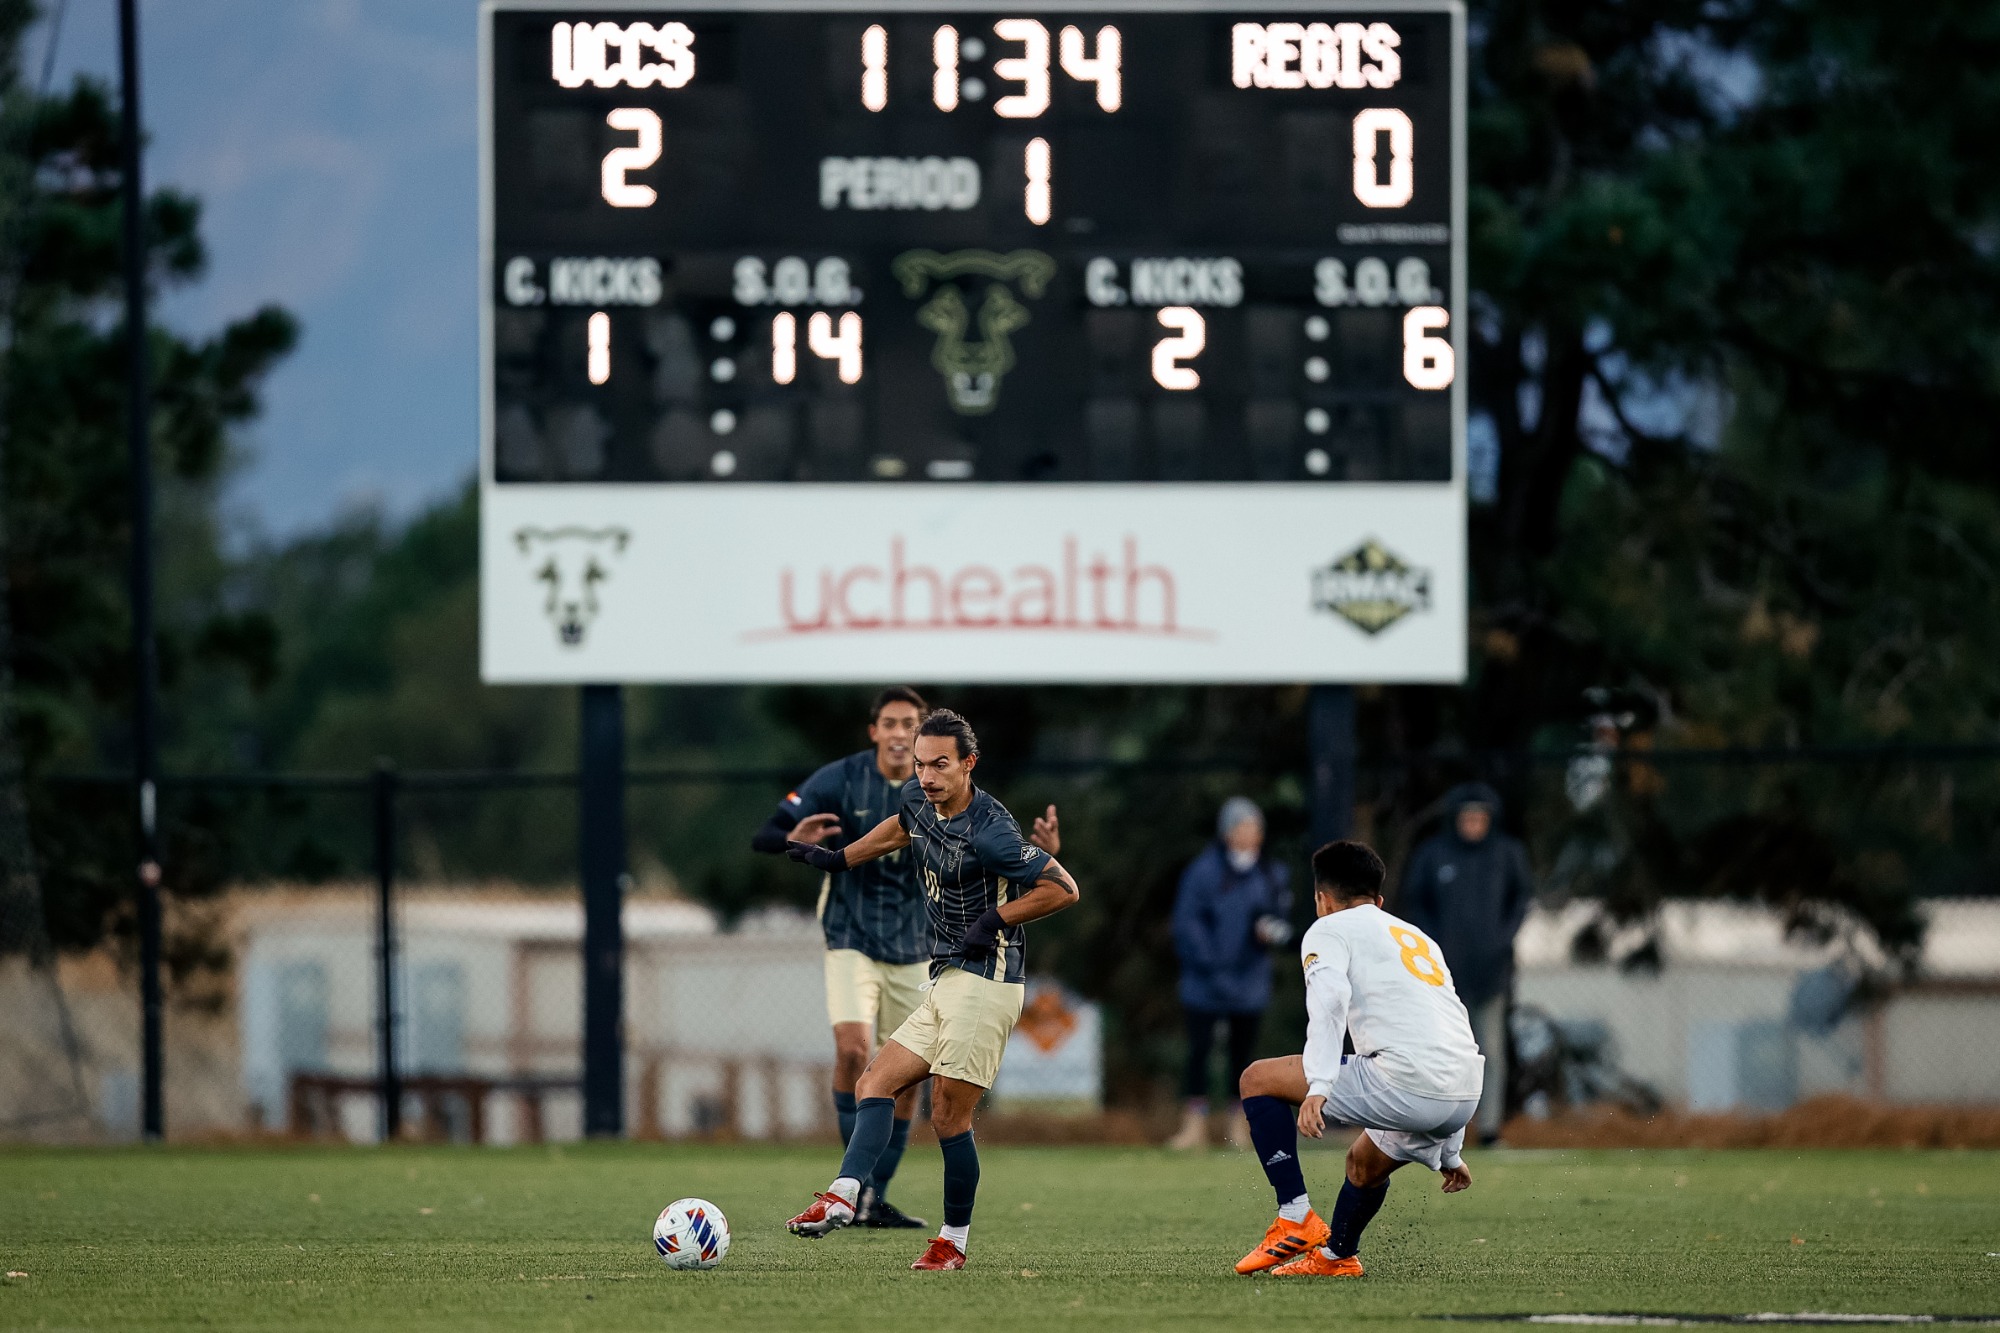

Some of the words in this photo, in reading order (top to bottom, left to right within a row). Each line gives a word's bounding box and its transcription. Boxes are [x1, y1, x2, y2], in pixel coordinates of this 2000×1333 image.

[552, 22, 695, 88] UCCS
[861, 19, 1121, 118] 11:34
[1232, 23, 1401, 88] REGIS
[601, 108, 662, 207] 2
[820, 157, 980, 209] PERIOD
[1025, 137, 1050, 225] 1
[1353, 108, 1413, 208] 0
[505, 256, 545, 305] C.
[550, 257, 662, 305] KICKS
[733, 256, 864, 305] S.O.G.
[1086, 256, 1126, 306] C.
[1130, 257, 1243, 306] KICKS
[1314, 256, 1443, 306] S.O.G.
[588, 312, 611, 385] 1
[772, 312, 863, 385] 14
[1152, 306, 1206, 390] 2
[1403, 306, 1455, 390] 6
[778, 534, 1180, 632] uchealth
[923, 866, 940, 903] 10
[1389, 925, 1445, 986] 8
